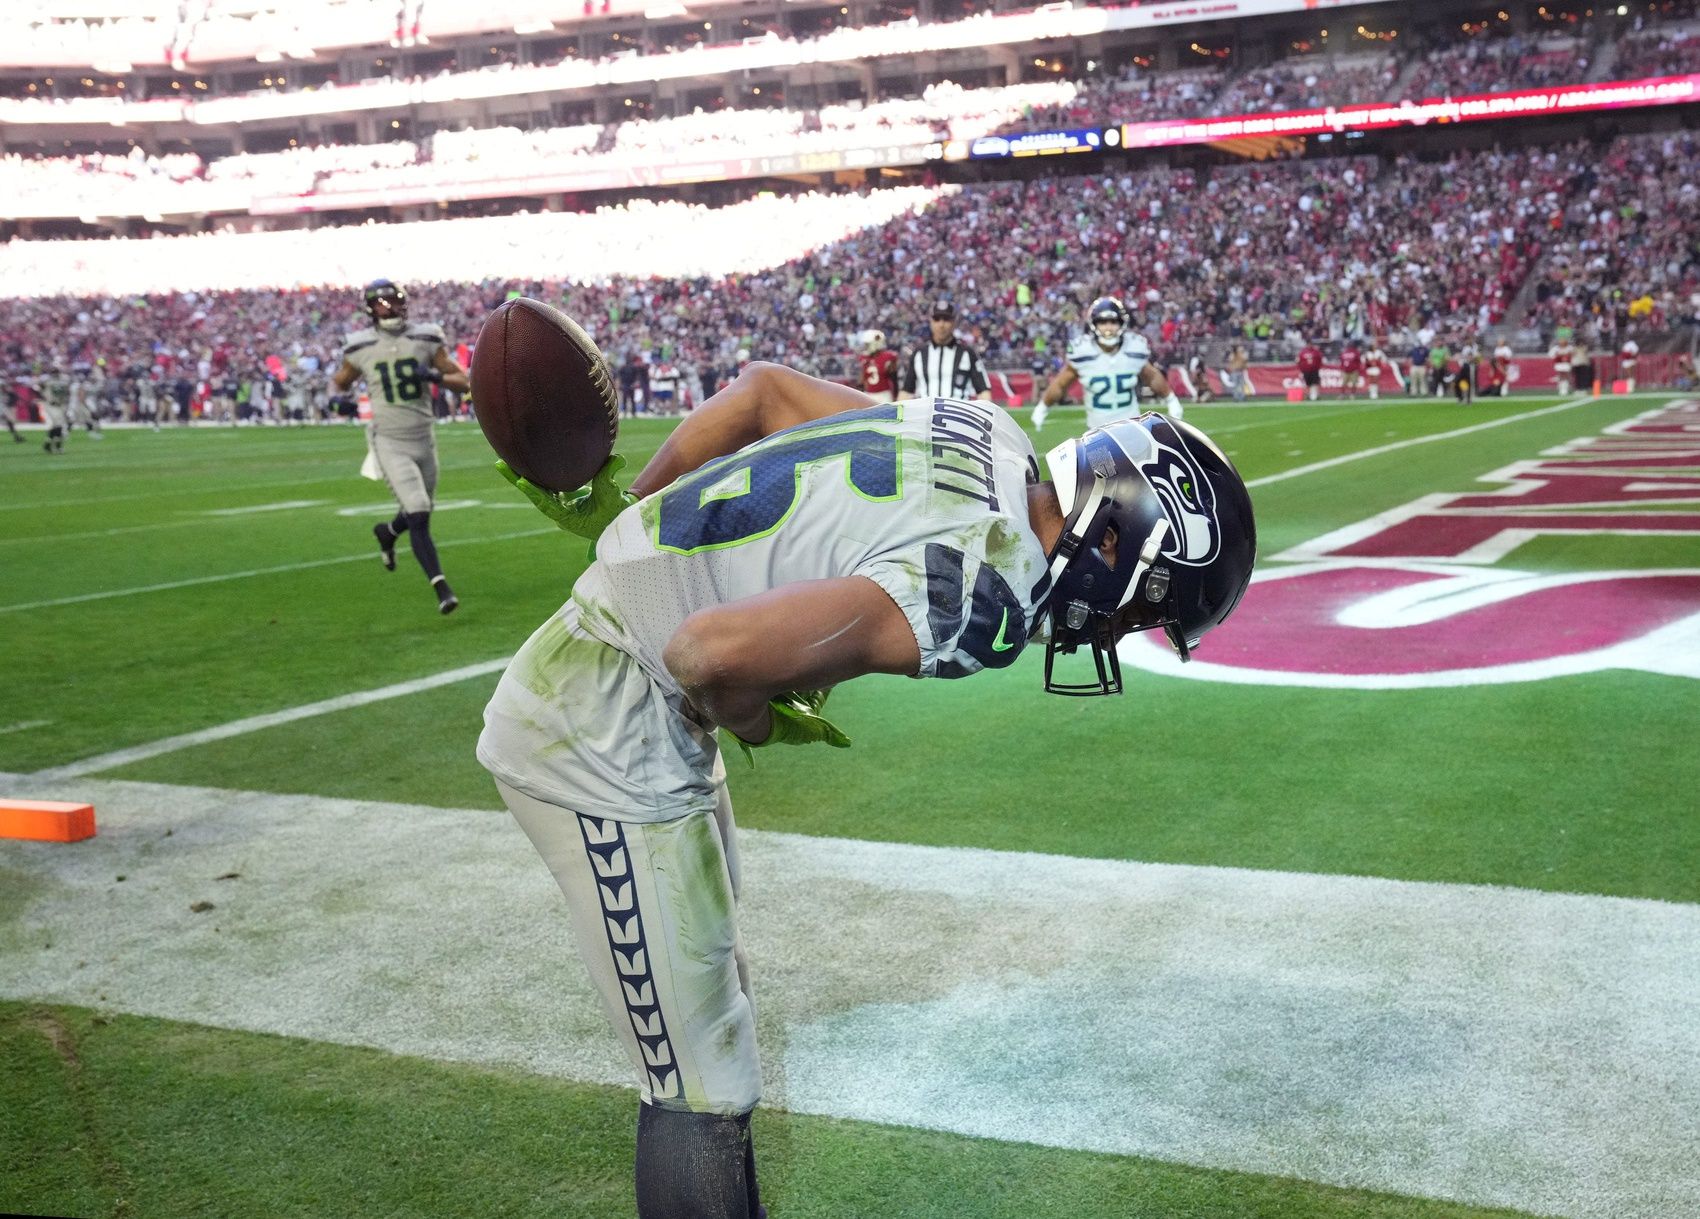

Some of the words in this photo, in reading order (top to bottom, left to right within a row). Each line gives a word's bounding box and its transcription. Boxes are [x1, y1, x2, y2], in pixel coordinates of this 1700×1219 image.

[374, 357, 422, 403] 18
[866, 366, 880, 385] 3
[1089, 373, 1135, 409] 25
[931, 397, 1001, 513] LOCKETT
